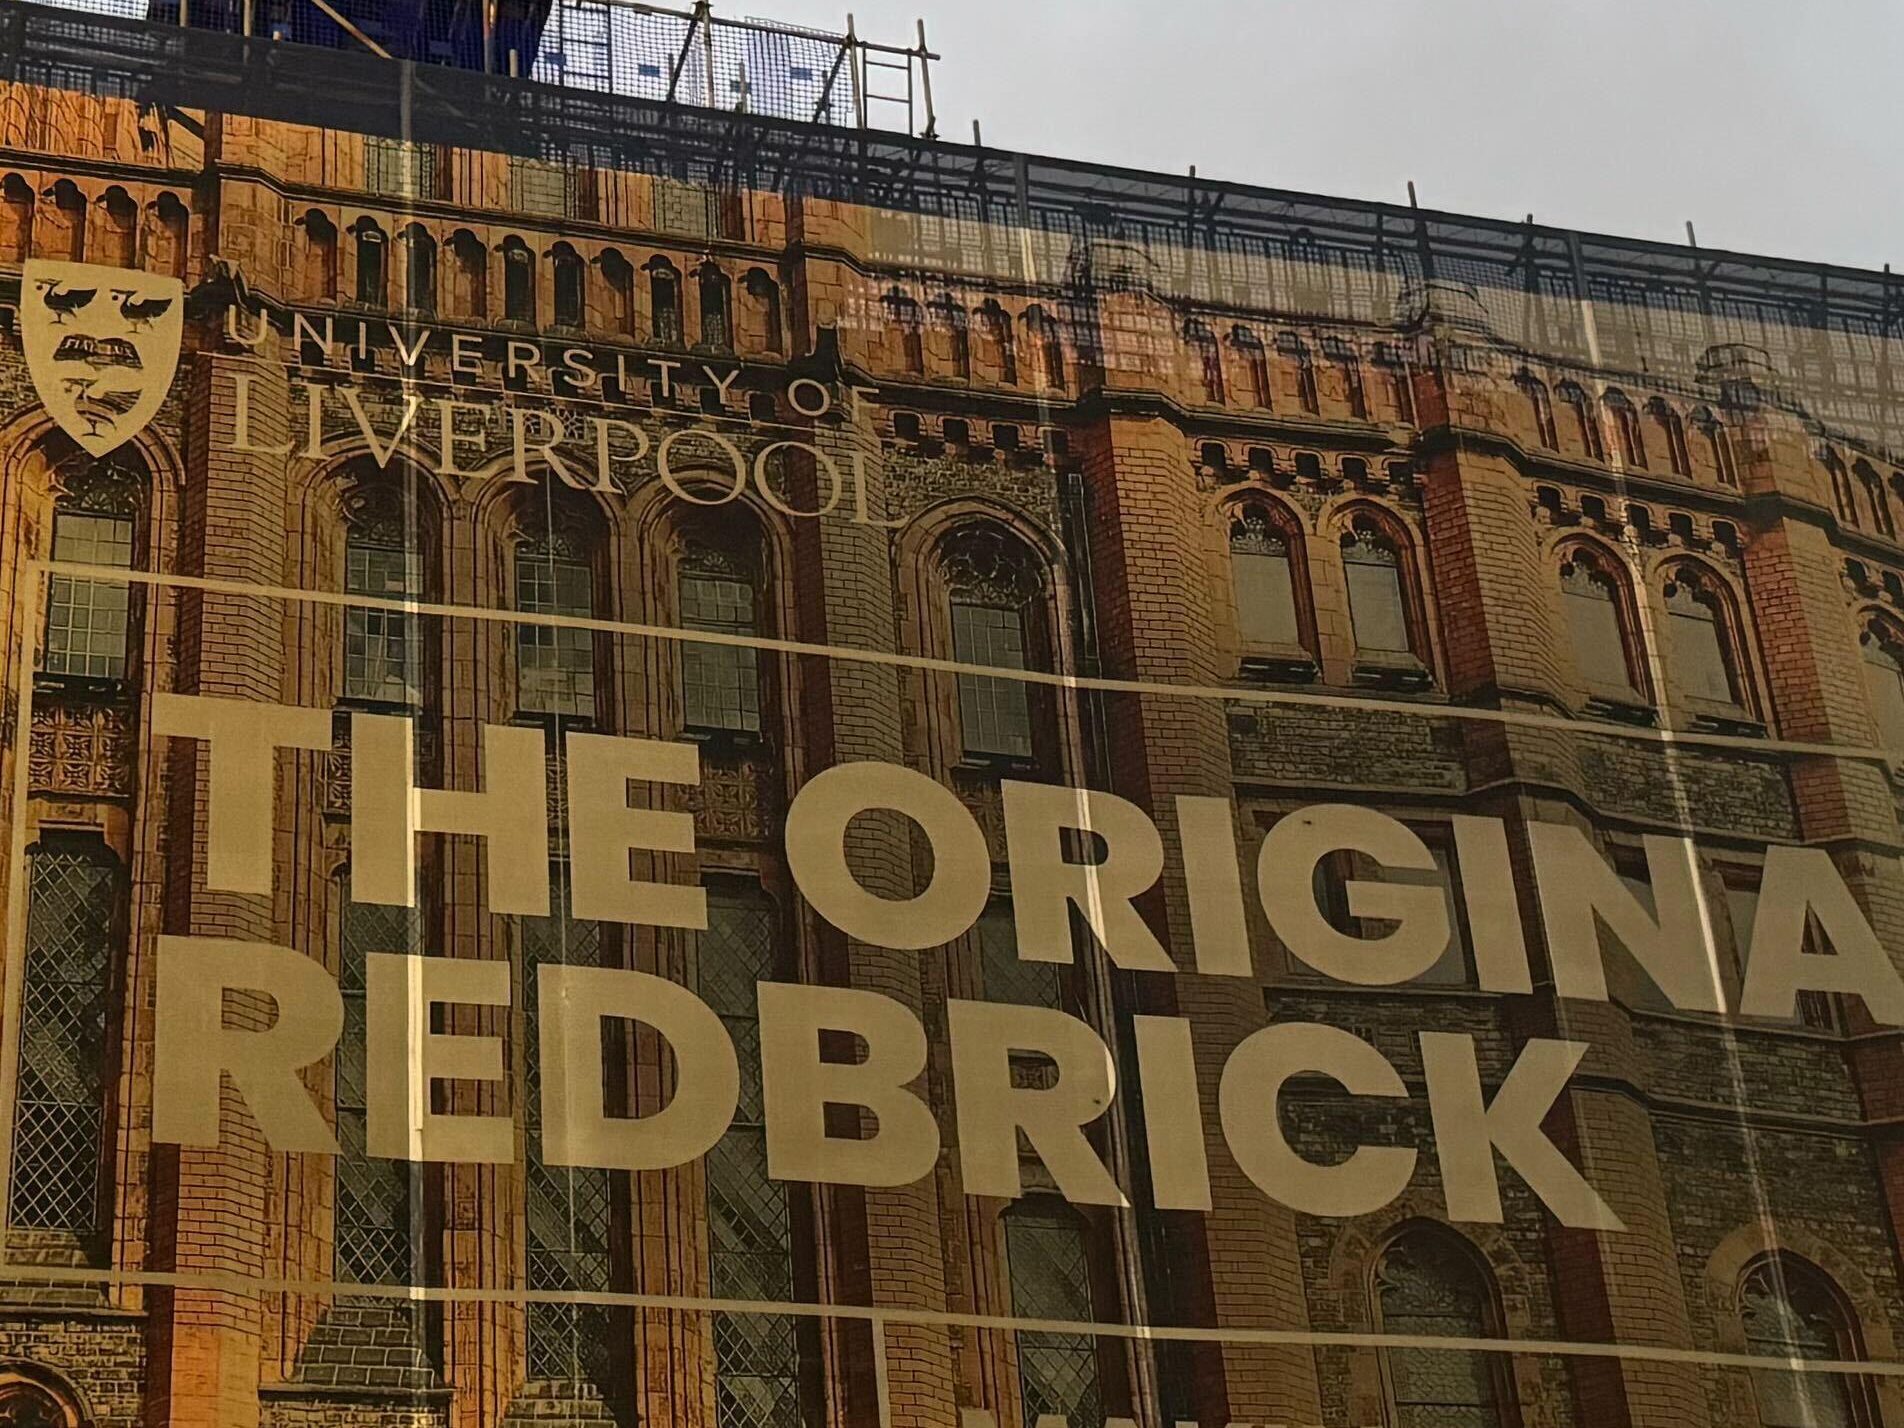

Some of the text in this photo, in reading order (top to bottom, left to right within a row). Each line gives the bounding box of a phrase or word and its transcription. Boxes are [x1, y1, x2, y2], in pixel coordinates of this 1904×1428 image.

[226, 303, 882, 420] UNIVERSITY OF
[234, 374, 906, 529] LIVERPOOL
[152, 693, 710, 930] THE
[149, 933, 1626, 1233] REDBRICK
